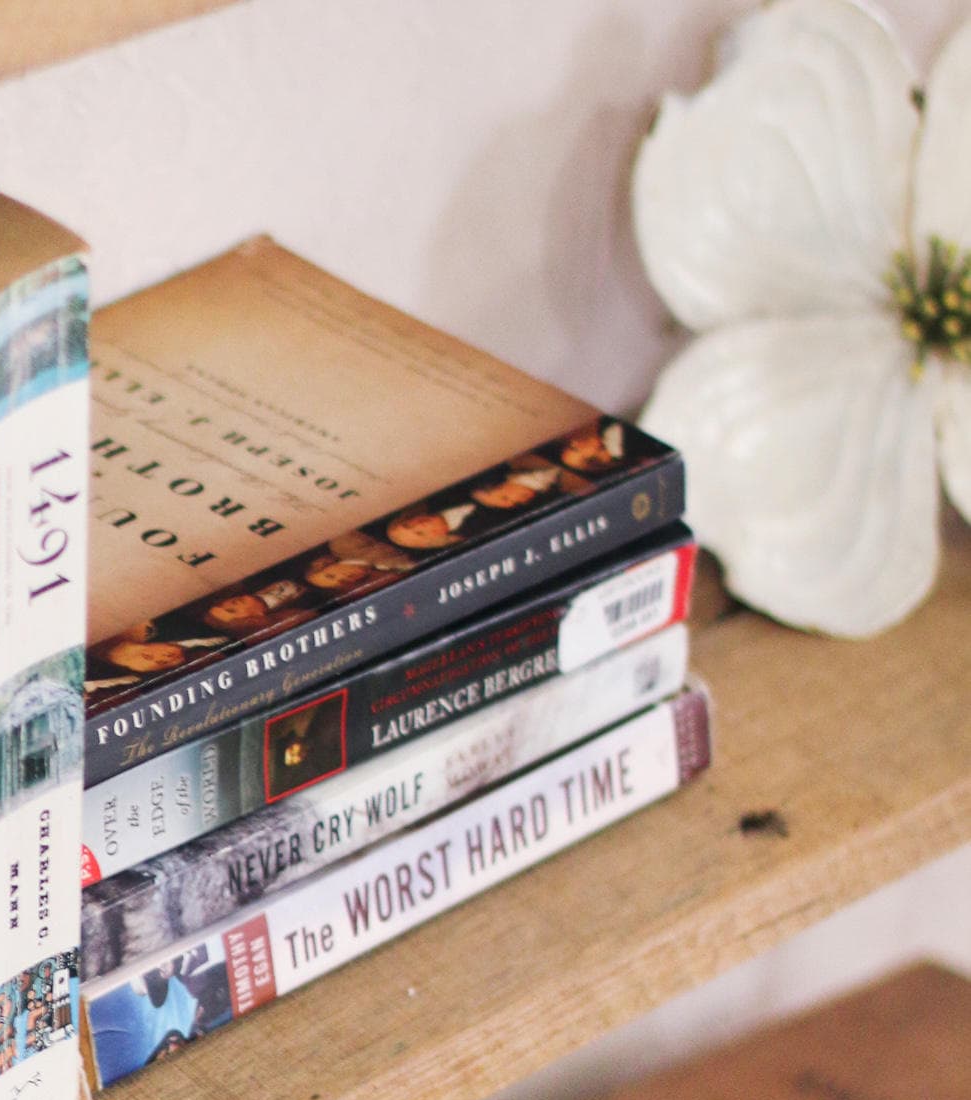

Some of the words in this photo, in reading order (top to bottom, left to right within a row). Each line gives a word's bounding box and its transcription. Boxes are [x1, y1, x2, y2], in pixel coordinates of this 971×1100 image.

[18, 449, 79, 601] 1491
[90, 493, 218, 568] FOU
[95, 670, 234, 746] FOUNDING
[245, 605, 378, 679] BROTHERS
[437, 556, 516, 605] JOSEPH
[523, 548, 542, 567] J.
[549, 515, 610, 553] ELLIS
[162, 690, 278, 748] Revolutionary
[281, 648, 366, 696] Generation
[372, 682, 481, 750] LAURENCE
[483, 647, 559, 700] BERGRE
[103, 793, 119, 857] OVER
[126, 803, 140, 829] the
[150, 775, 167, 839] EDGE
[228, 831, 303, 897] NEVER
[312, 805, 356, 855] CRY
[365, 771, 424, 827] WOLF
[9, 860, 20, 930] MANN
[38, 808, 51, 919] CHARLES
[284, 922, 335, 971] The
[343, 841, 452, 938] WORST
[465, 793, 549, 877] HARD
[559, 746, 634, 824] TIME
[250, 936, 271, 988] EGAN
